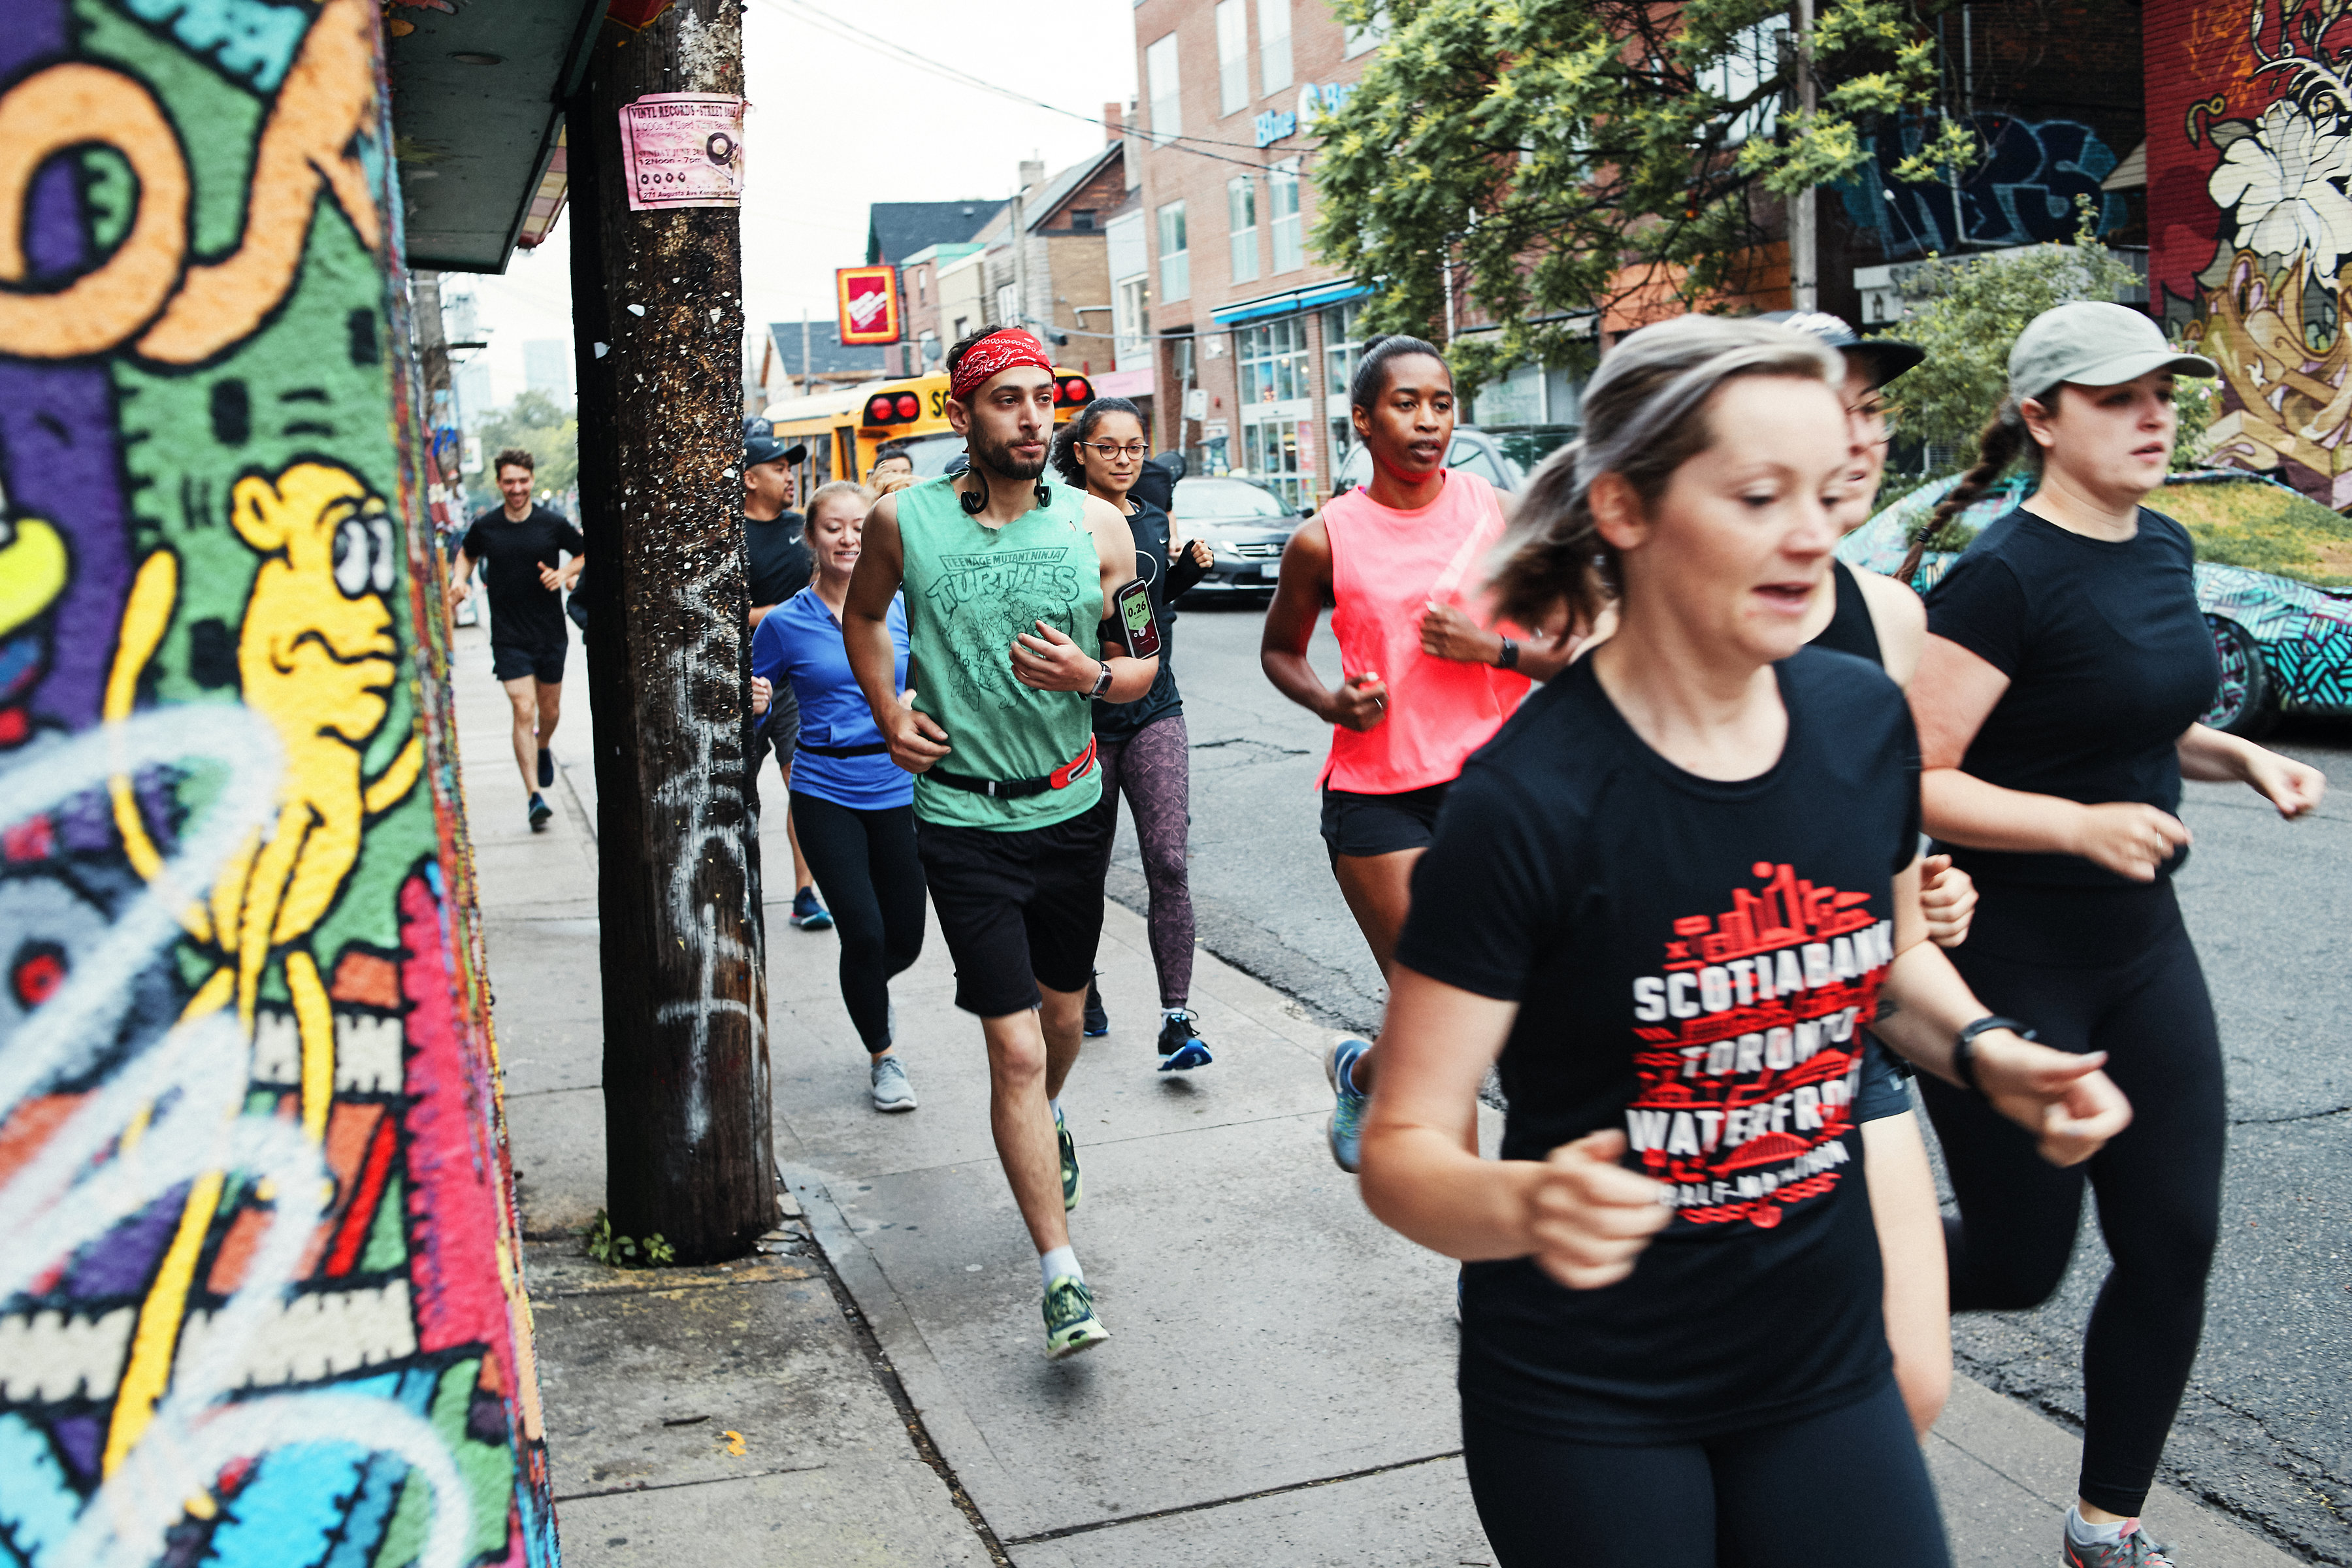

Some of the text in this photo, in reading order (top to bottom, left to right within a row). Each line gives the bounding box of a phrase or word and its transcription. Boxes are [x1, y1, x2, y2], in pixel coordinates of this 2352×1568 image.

[631, 106, 657, 118] VINYL
[659, 105, 694, 117] RECORDS
[1255, 109, 1296, 148] Blue
[658, 190, 685, 199] Augusta
[947, 550, 1062, 568] TEENAGE MUTANT NINJA
[925, 563, 1079, 615] TURTLES
[1128, 601, 1147, 618] 0.26
[1633, 919, 1893, 1022] SCOTIABANK
